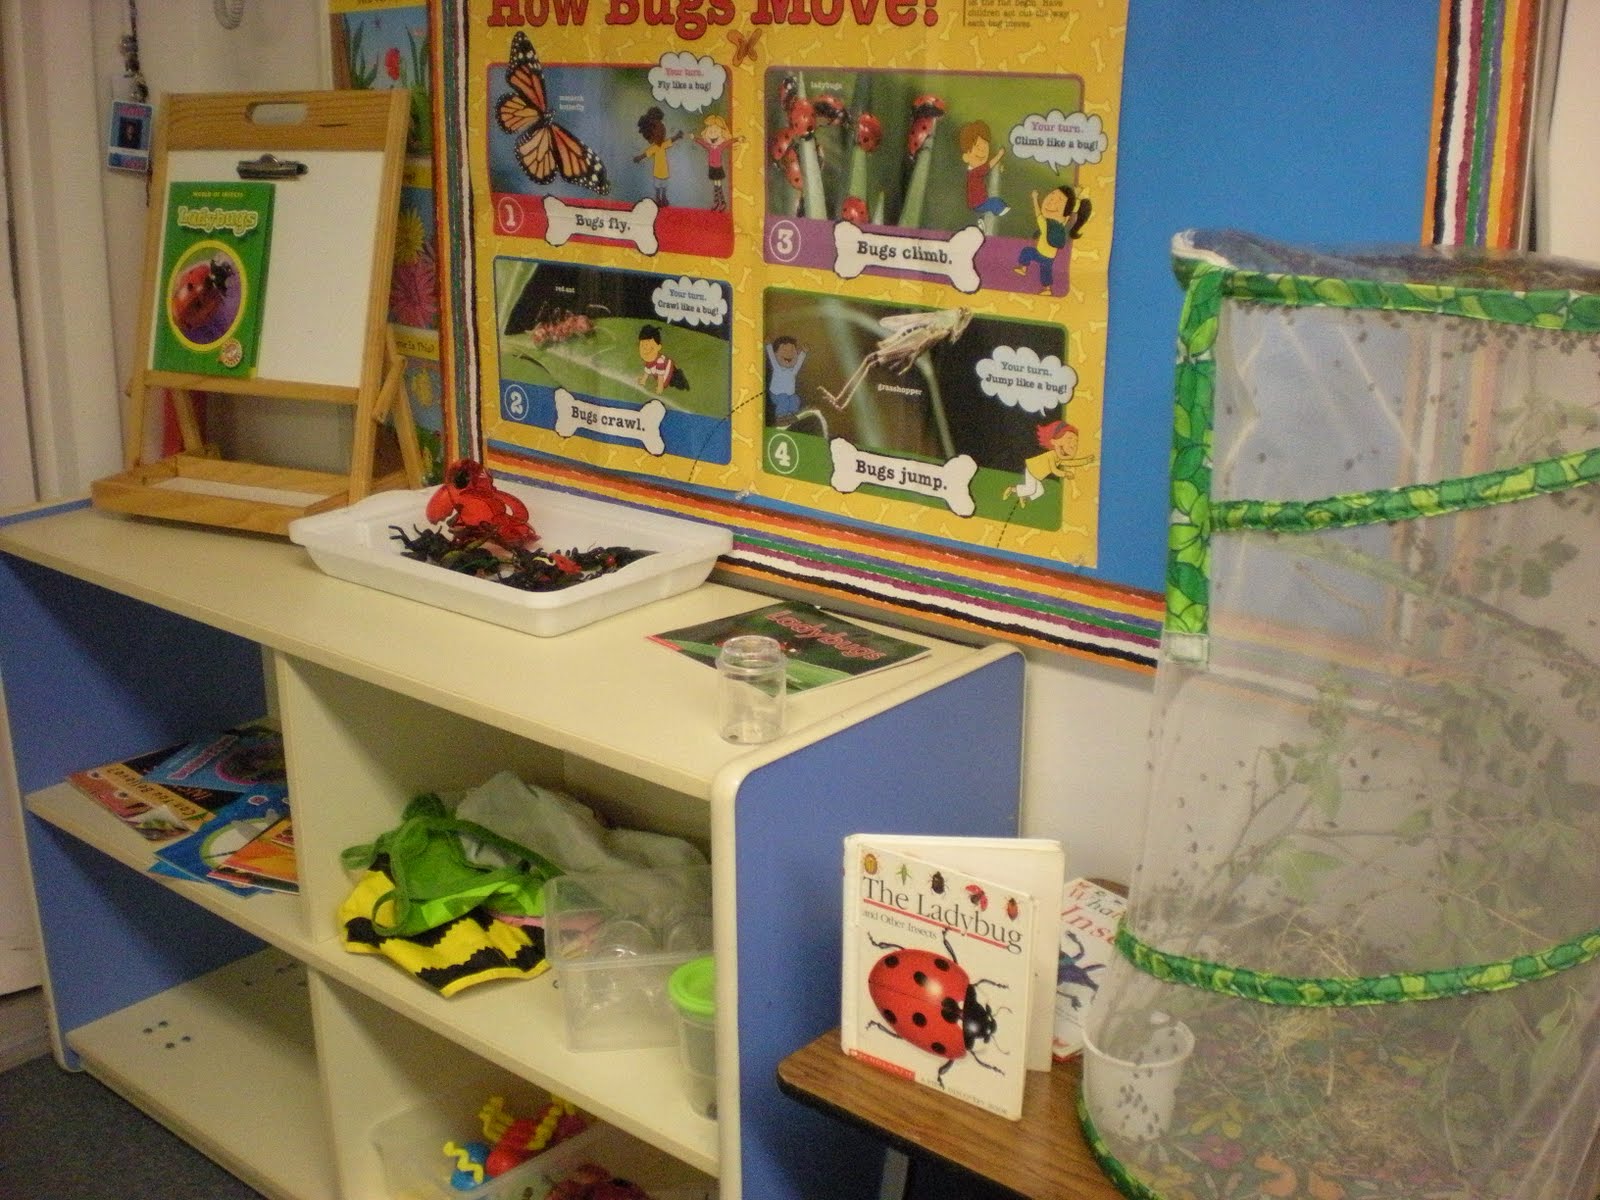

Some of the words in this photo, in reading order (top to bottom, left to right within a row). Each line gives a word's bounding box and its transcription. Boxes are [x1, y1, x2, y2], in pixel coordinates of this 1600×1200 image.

[486, 0, 586, 27] How
[604, 0, 735, 40] Bugs
[750, 0, 940, 27] Move!
[665, 68, 683, 77] Your
[658, 81, 671, 91] Fly
[672, 81, 687, 89] like
[695, 82, 712, 92] bug!
[1032, 121, 1055, 132] Your
[1057, 123, 1083, 134] turn.
[1015, 136, 1044, 147] Climb
[1046, 138, 1066, 148] like
[1077, 140, 1099, 152] bug!
[177, 205, 258, 236] Ladybugs
[504, 204, 517, 226] 1
[575, 214, 604, 230] Bugs
[608, 216, 631, 231] fly.
[776, 228, 794, 255] 3
[857, 240, 896, 260] Bugs
[902, 247, 953, 265] climb.
[669, 288, 687, 298] Your
[688, 292, 707, 301] turn.
[658, 299, 679, 309] Crawl
[681, 302, 695, 312] like
[702, 305, 719, 317] bug!
[1001, 361, 1025, 372] Your
[1027, 365, 1053, 377] turn.
[877, 383, 923, 396] grasshopper
[986, 373, 1014, 386] Jump
[1016, 378, 1035, 389] like
[1046, 382, 1067, 394] bug!
[510, 391, 523, 413] 2
[571, 405, 599, 425] Bugs
[601, 411, 646, 431] crawl.
[775, 441, 791, 467] 4
[856, 459, 895, 481] Bugs
[899, 467, 948, 490] jump.
[765, 609, 886, 661] Ladybugs
[862, 909, 879, 921] and
[880, 913, 906, 929] Other
[908, 921, 938, 940] Insects
[863, 876, 909, 910] The
[917, 893, 1024, 953] Ladybug
